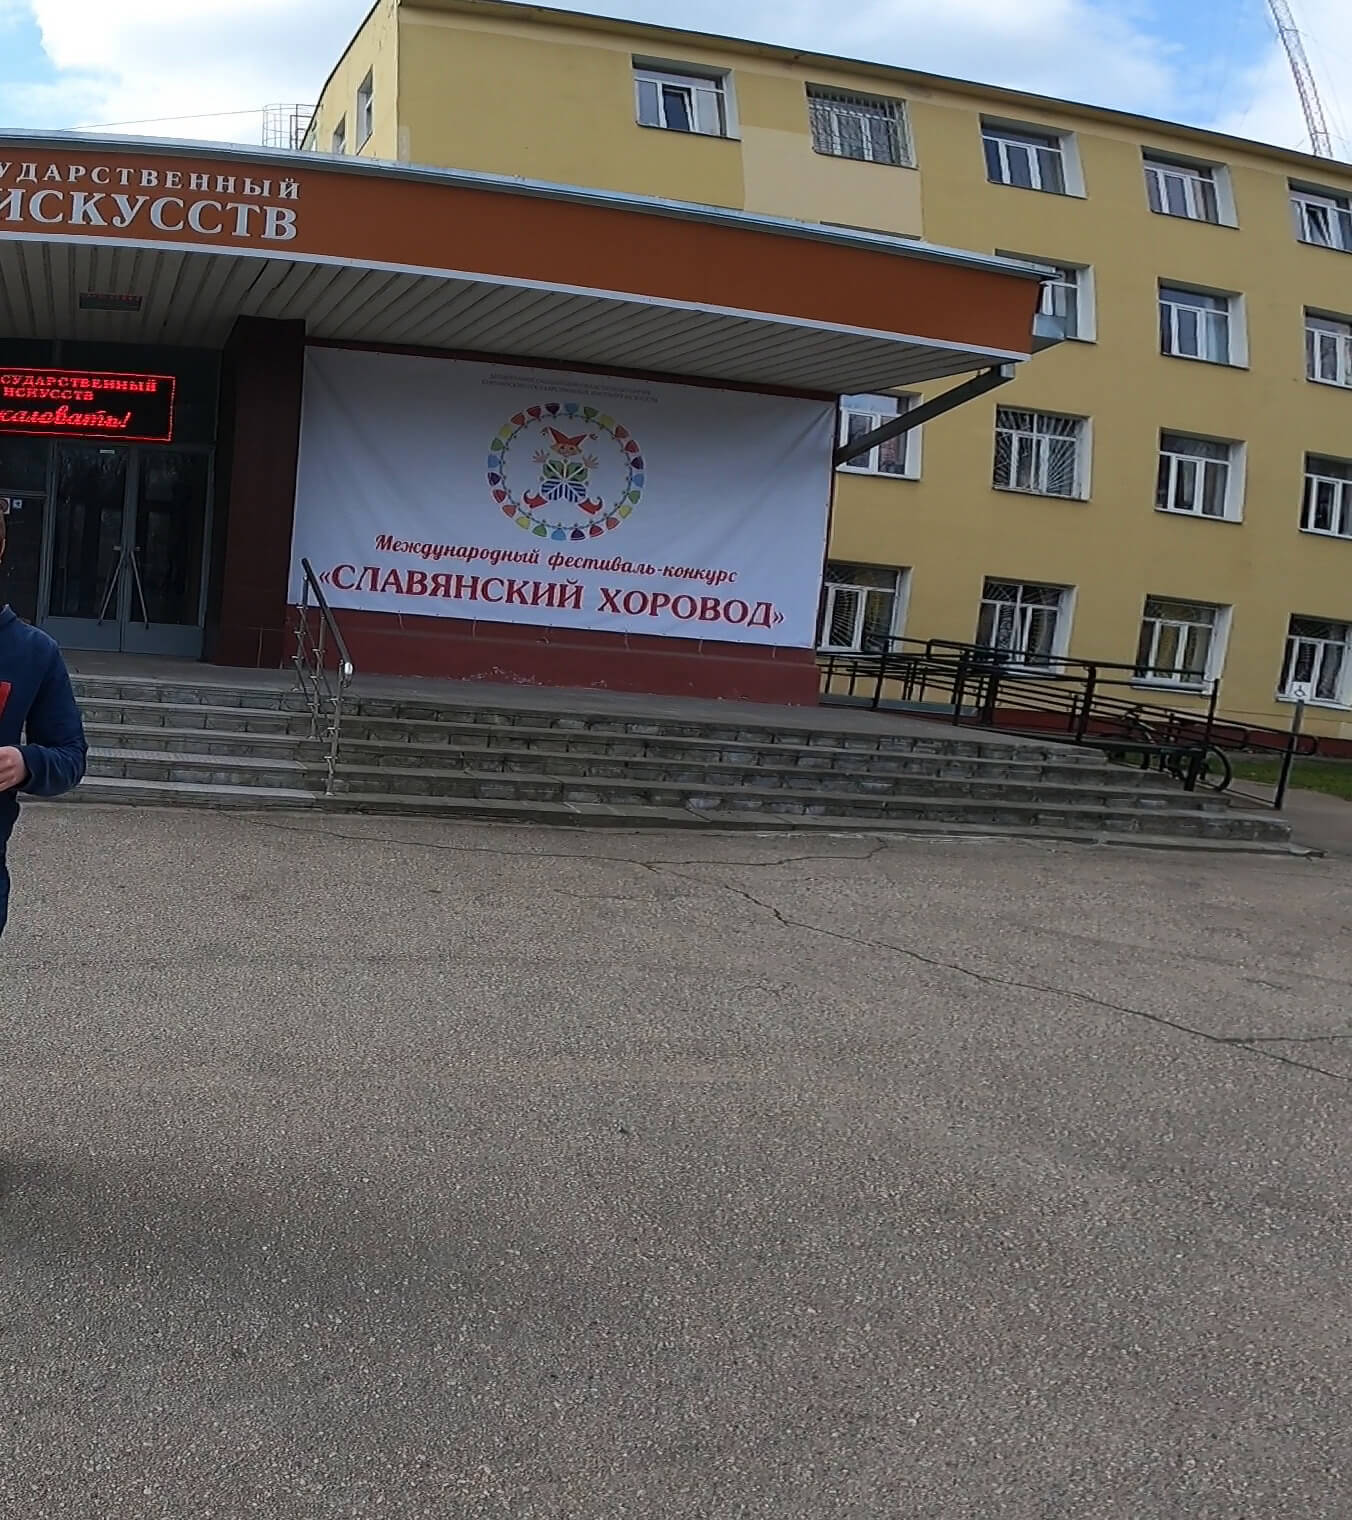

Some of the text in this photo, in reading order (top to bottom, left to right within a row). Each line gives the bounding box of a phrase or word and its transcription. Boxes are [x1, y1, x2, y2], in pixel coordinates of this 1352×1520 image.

[3, 387, 95, 401] ИСКУССТВ
[375, 534, 739, 586] Международный фестиваль-конкурс
[319, 563, 784, 629] «СЛАВЯНСКИЙ ХОРОВОД»
